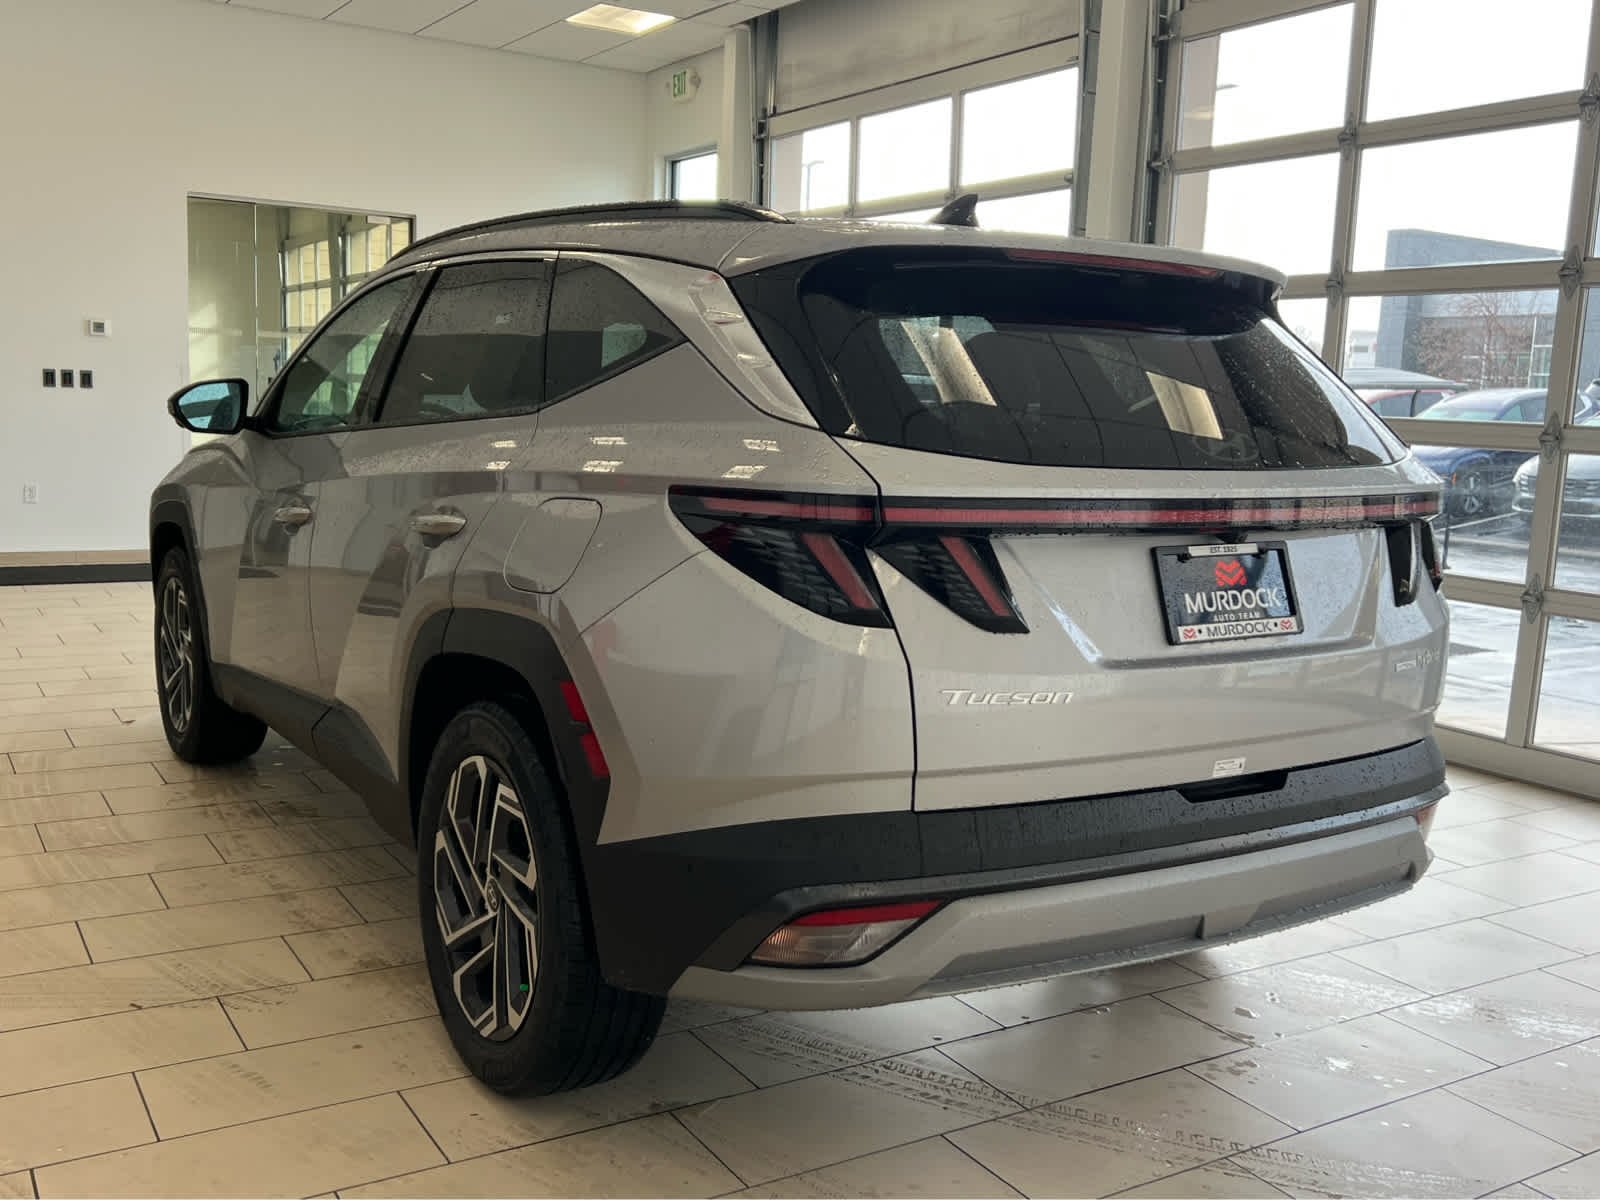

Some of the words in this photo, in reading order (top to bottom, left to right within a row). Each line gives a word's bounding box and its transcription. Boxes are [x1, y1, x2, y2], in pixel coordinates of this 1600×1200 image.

[672, 71, 687, 98] EXIT
[1184, 586, 1282, 614] MURDOCK
[1213, 613, 1236, 622] AUTO
[1239, 610, 1261, 620] TEAM
[1206, 621, 1273, 637] MURDOCK
